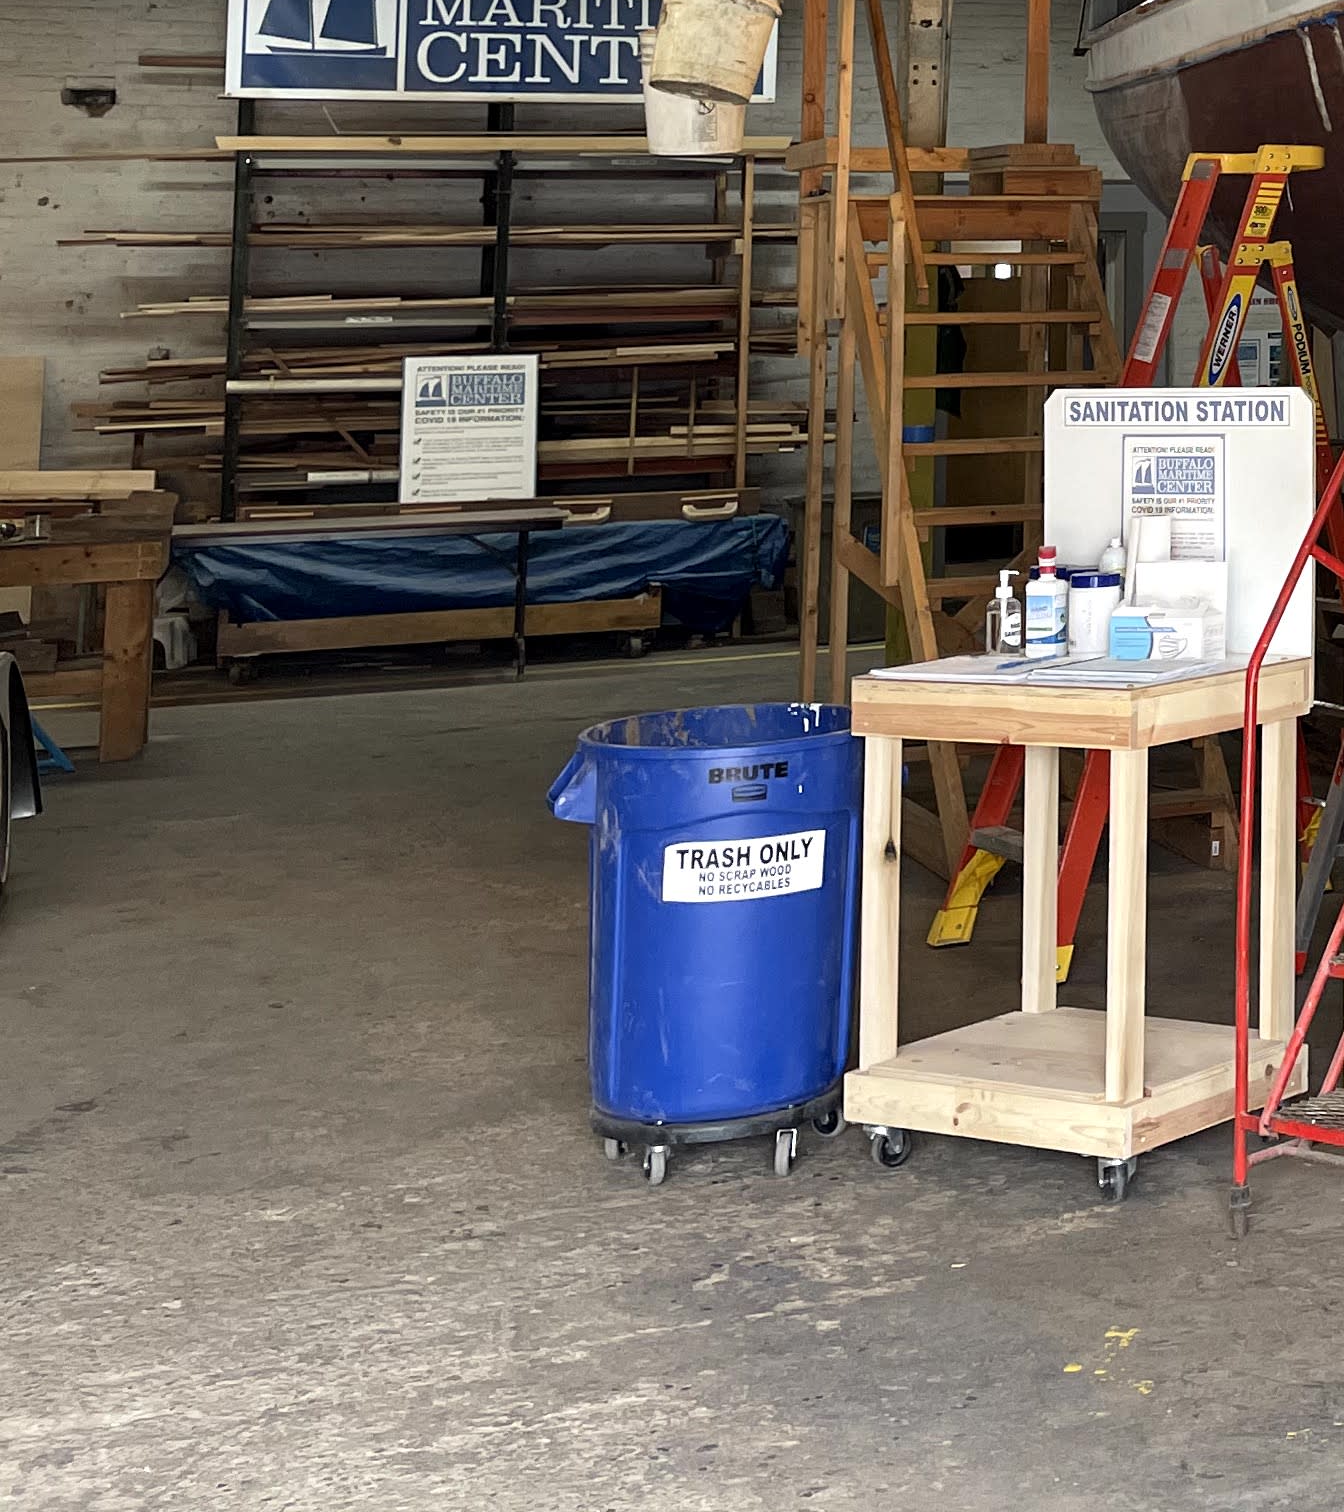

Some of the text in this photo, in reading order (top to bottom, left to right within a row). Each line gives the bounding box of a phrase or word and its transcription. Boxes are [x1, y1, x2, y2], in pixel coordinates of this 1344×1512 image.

[416, 31, 641, 84] CENT
[1213, 310, 1238, 368] WERNER
[1292, 324, 1311, 374] PODIUM
[452, 374, 523, 385] BUFFALO
[450, 393, 522, 405] CENTER
[1069, 400, 1284, 422] SANITATION STATION
[1159, 458, 1213, 469] BUFFALO
[1159, 470, 1213, 480] MARITIME
[1158, 480, 1213, 493] CENTER
[709, 761, 789, 784] BRUTE
[676, 837, 813, 869] TRASH ONLY
[699, 864, 791, 882] NO SCRAP WOOD
[699, 878, 790, 895] NO RECYCABLES
